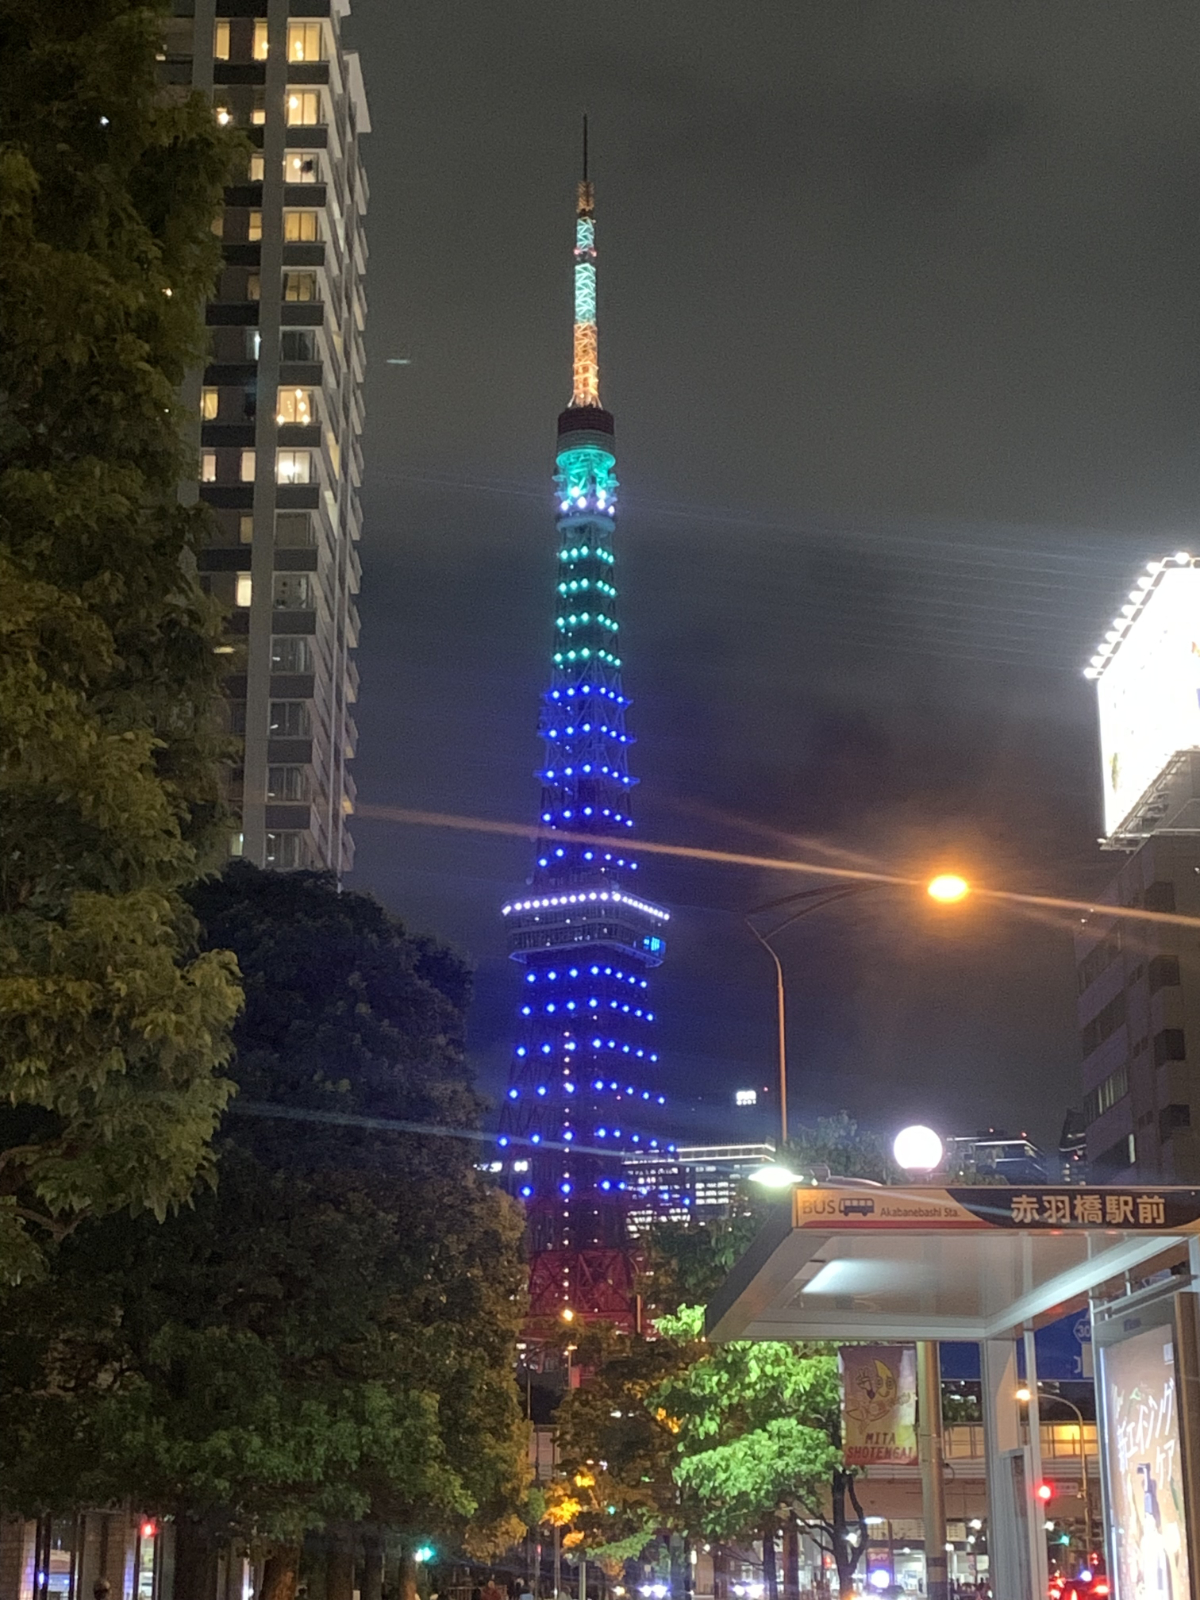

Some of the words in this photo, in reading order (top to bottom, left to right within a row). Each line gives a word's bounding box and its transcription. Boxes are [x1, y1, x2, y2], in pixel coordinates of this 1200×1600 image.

[803, 1199, 835, 1214] BUS
[880, 1207, 942, 1218] Akabanebashi
[943, 1207, 960, 1218] Sta.
[1011, 1195, 1165, 1224] 赤羽橋駅前
[865, 1432, 896, 1445] MITA
[847, 1446, 914, 1460] SHOTENGAI
